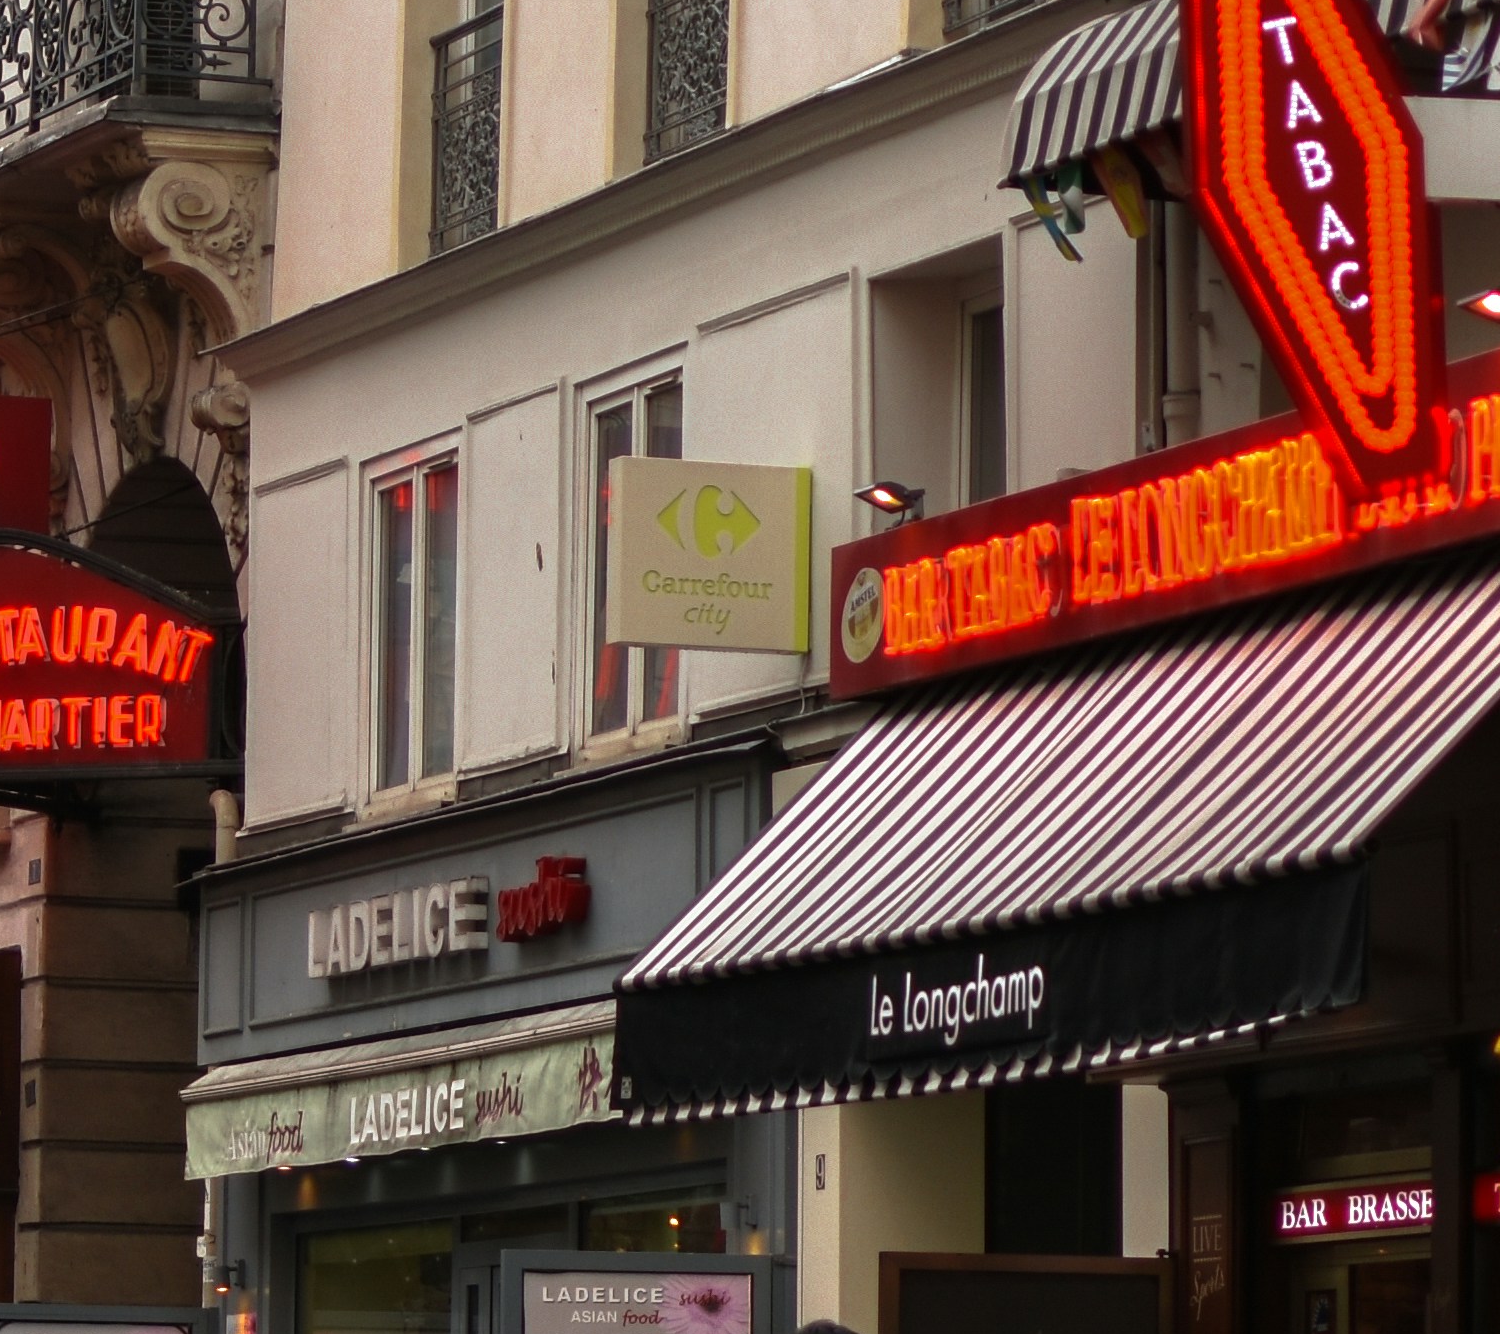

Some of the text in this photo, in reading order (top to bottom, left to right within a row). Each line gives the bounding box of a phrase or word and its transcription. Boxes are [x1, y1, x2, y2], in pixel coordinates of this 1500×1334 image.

[1262, 15, 1369, 310] TABAC
[641, 569, 774, 601] Carrefour
[848, 585, 879, 617] AMSTEL
[683, 602, 732, 636] city
[307, 874, 490, 979] LADELICE
[903, 952, 1045, 1046] Longchamp
[266, 1110, 304, 1165] food
[349, 1077, 467, 1145] LADELICE
[474, 1071, 526, 1127] sushi
[815, 1154, 826, 1190] 9
[1281, 1198, 1328, 1229] BAR
[1192, 1224, 1223, 1253] LIVE
[542, 1285, 732, 1307] LADELICE sushi
[1189, 1263, 1226, 1322] Sports
[570, 1309, 664, 1327] ASIAN food
